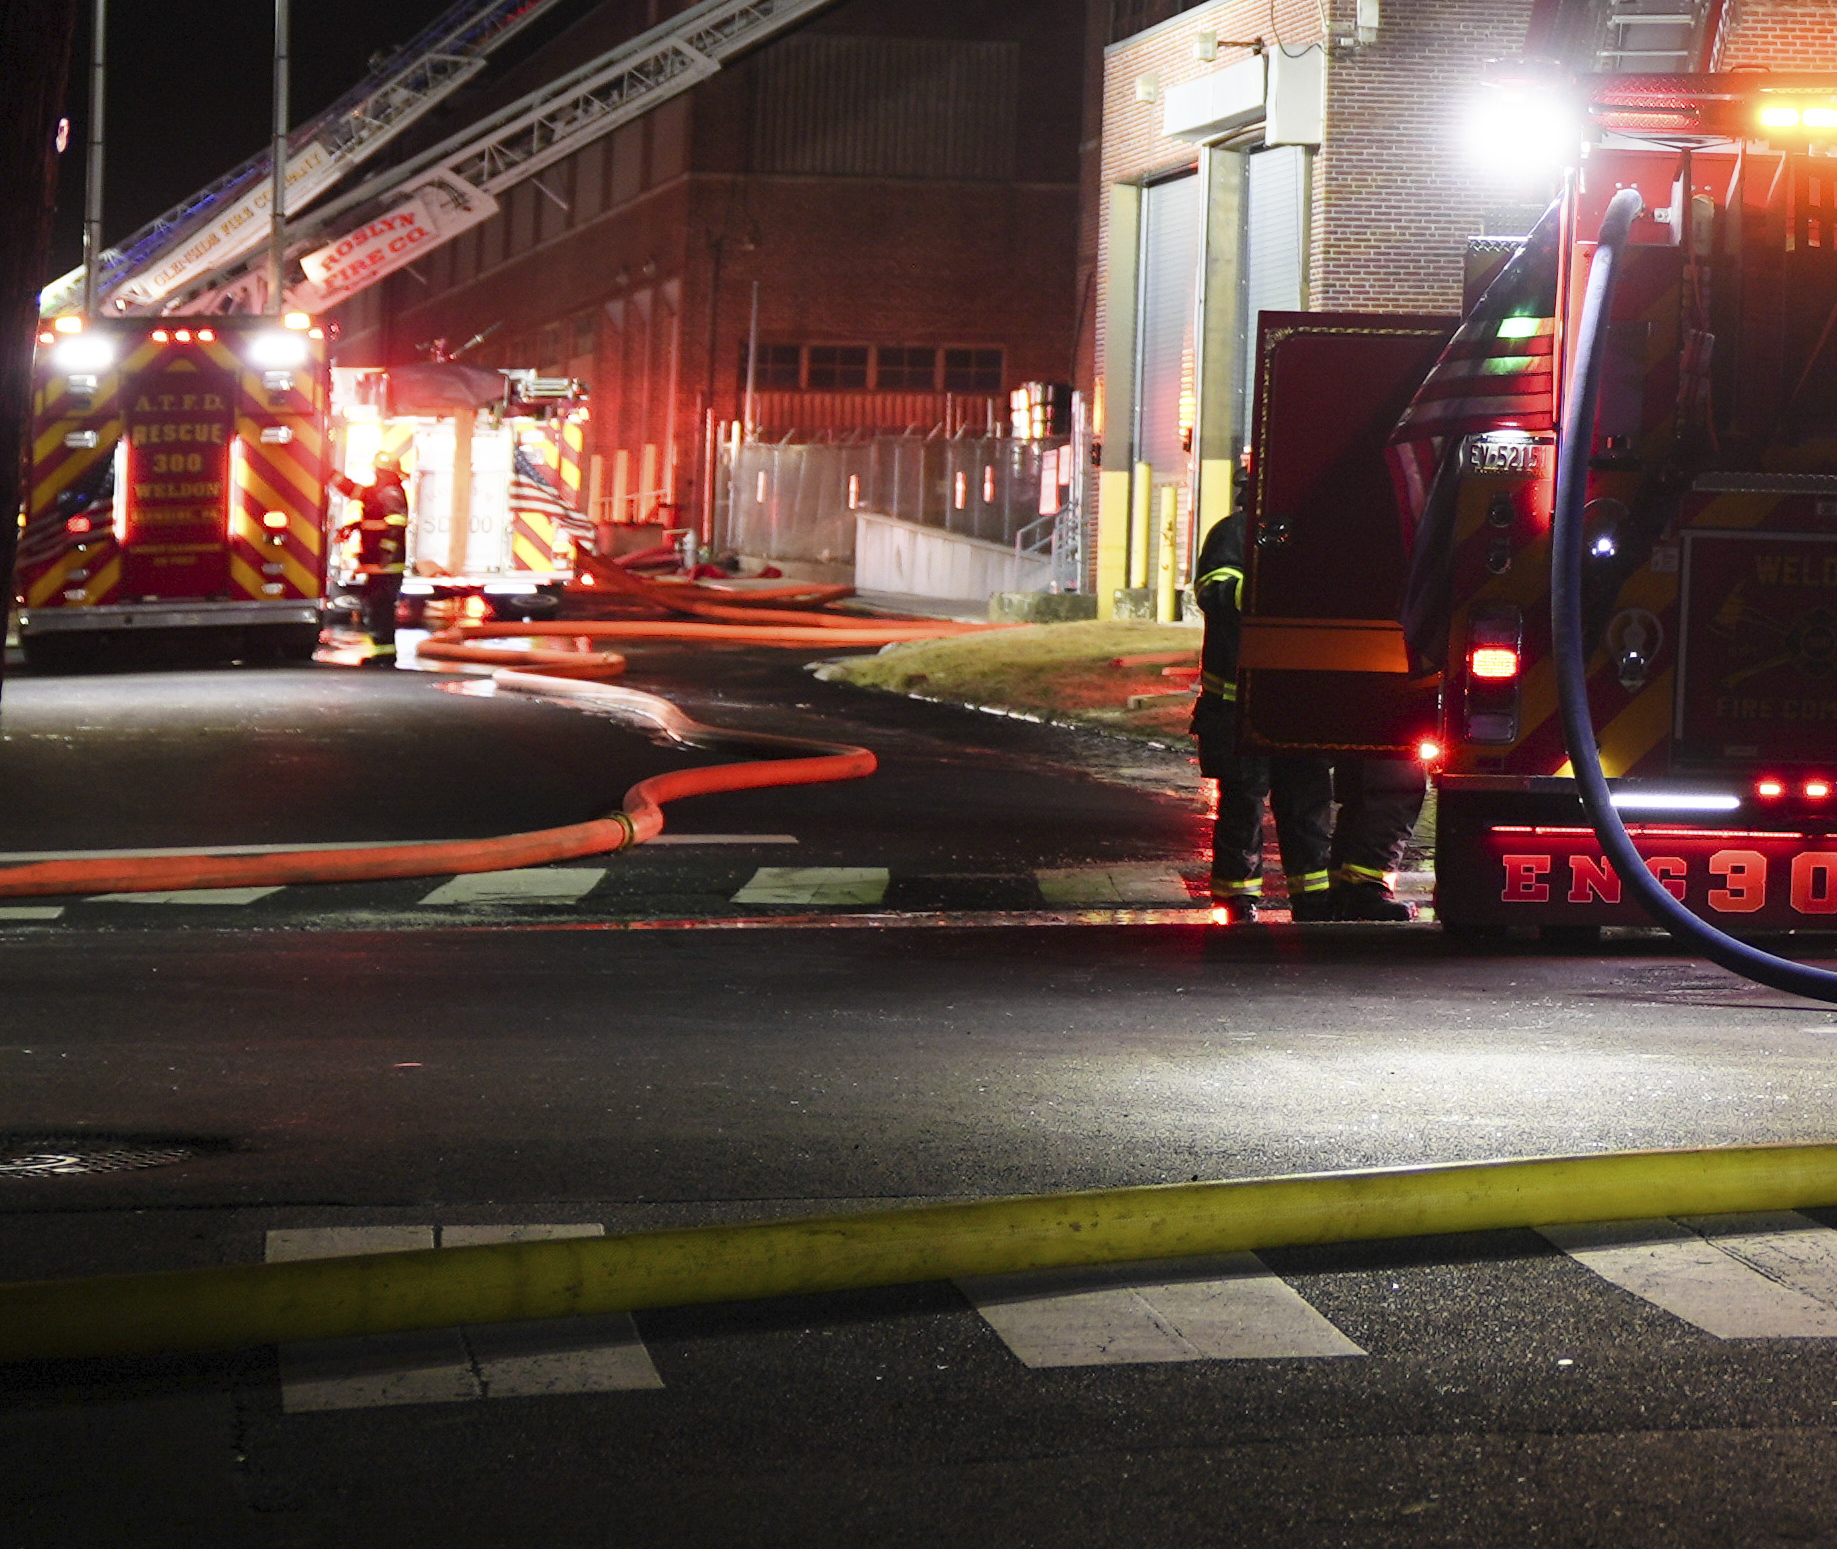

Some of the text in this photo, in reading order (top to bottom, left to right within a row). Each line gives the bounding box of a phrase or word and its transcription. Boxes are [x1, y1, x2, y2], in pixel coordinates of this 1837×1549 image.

[321, 212, 416, 272] ROSLYN
[323, 248, 386, 292] FIRE
[131, 423, 224, 447] RESCUE
[153, 453, 203, 472] 300
[1716, 698, 1773, 720] FIRE
